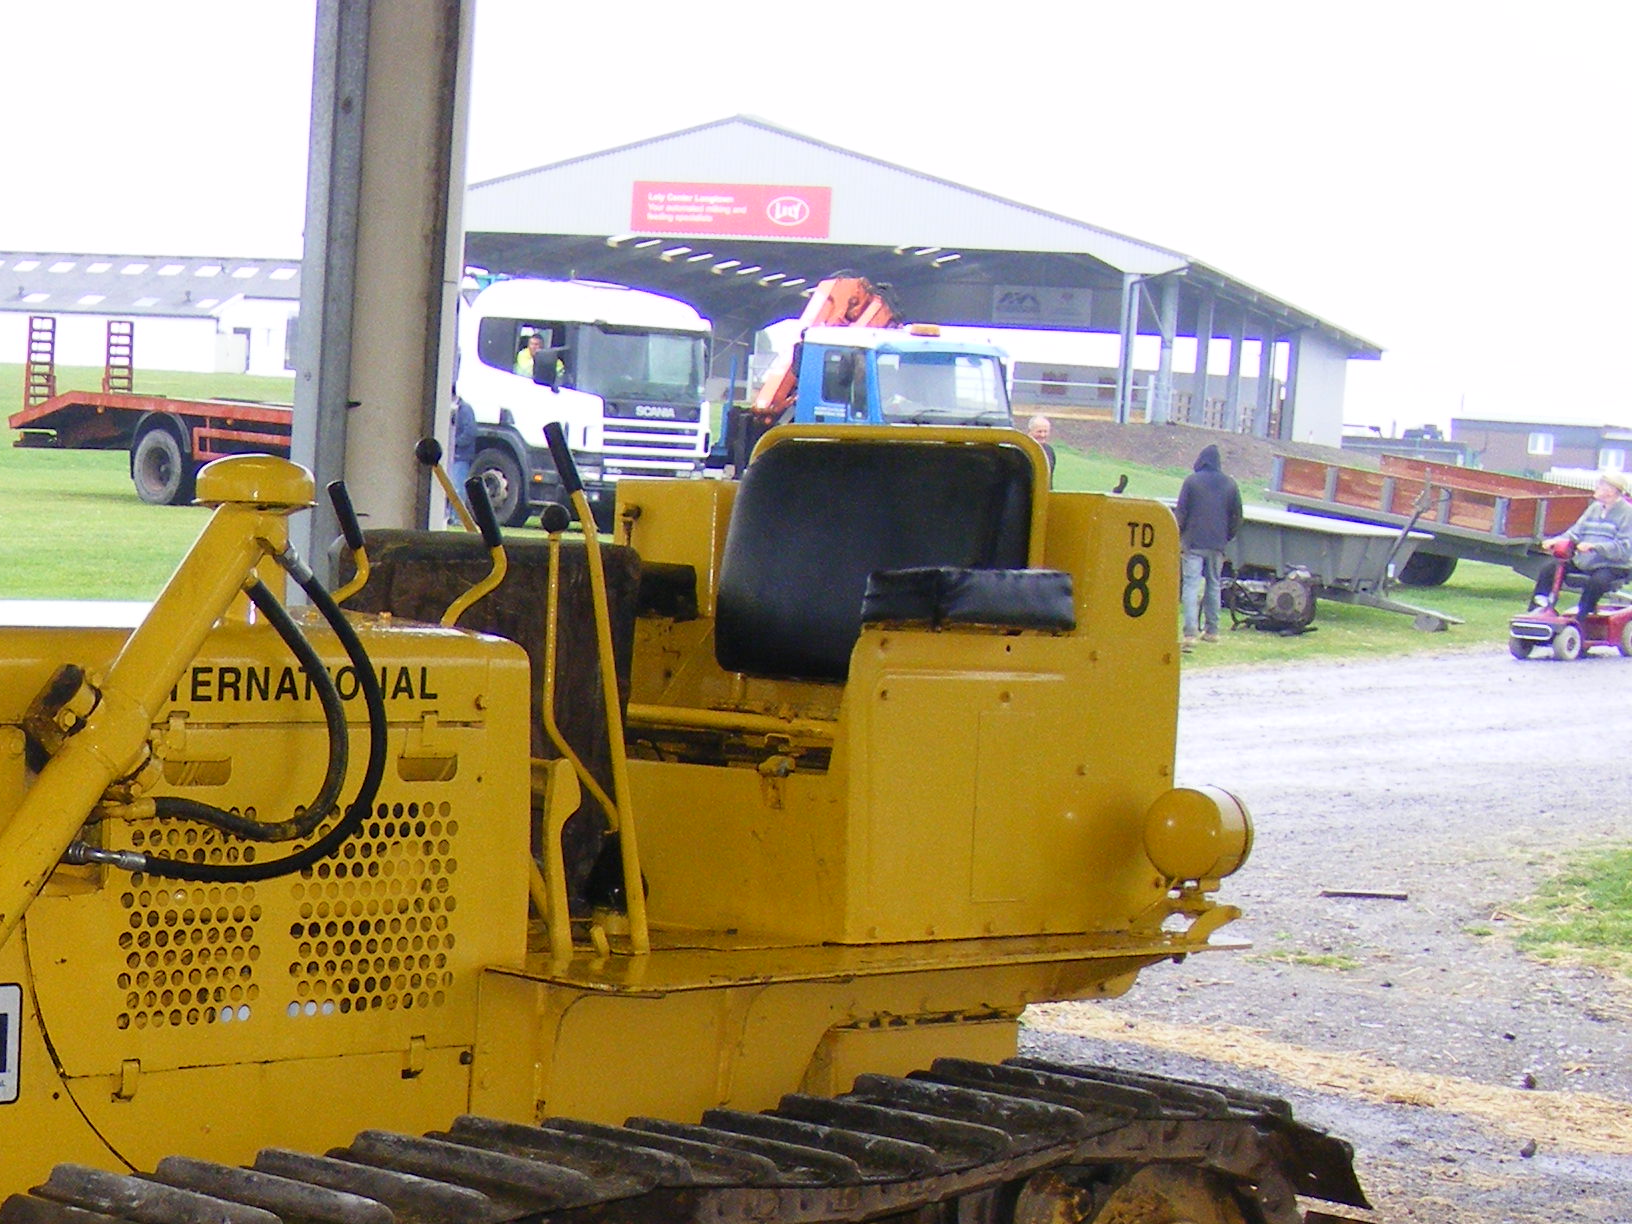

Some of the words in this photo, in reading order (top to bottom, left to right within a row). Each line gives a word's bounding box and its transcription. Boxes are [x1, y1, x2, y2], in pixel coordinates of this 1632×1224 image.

[635, 405, 676, 418] SCANIA
[1127, 522, 1154, 548] TD
[1123, 554, 1151, 618] 8
